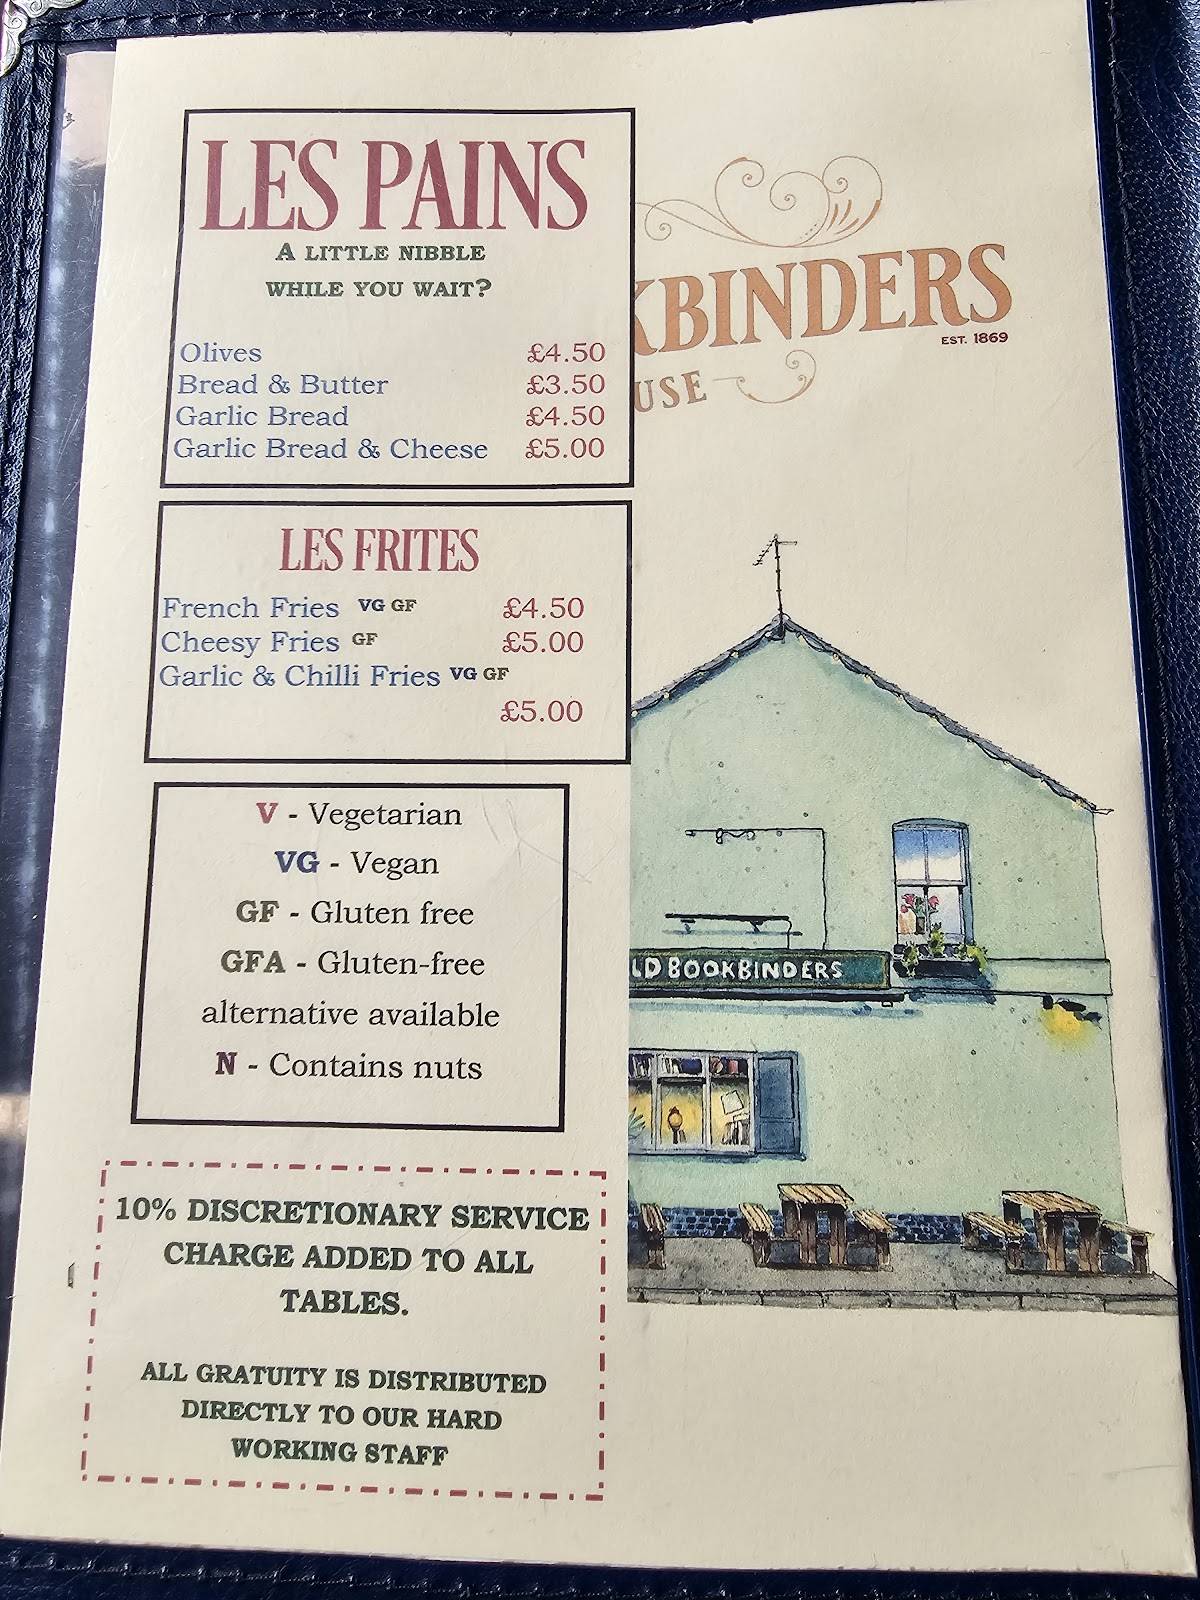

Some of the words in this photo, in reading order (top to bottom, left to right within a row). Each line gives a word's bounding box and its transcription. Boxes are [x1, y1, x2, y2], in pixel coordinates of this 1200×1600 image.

[199, 139, 338, 231] LES
[359, 139, 587, 230] PAINS
[275, 243, 296, 261] A
[305, 245, 389, 261] LITTLE
[399, 246, 486, 261] NIBBLE
[265, 282, 344, 298] WHILE
[353, 282, 404, 297] YOU
[413, 278, 492, 297] WAIT?
[942, 336, 967, 345] EST.
[974, 332, 1008, 343] 1869
[180, 342, 262, 362] Olives
[527, 343, 605, 363] £4.50
[177, 374, 258, 394] Bread
[268, 374, 290, 394] &
[300, 375, 389, 394] Butter
[527, 374, 605, 395] £3.50
[176, 405, 257, 425] Garlic
[268, 405, 348, 426] Bread
[526, 406, 604, 426] £4.50
[174, 437, 256, 458] Garlic
[265, 438, 347, 458] Bread
[358, 439, 380, 458] &
[390, 438, 487, 459] Cheese
[525, 438, 604, 458] £5.00
[278, 528, 343, 571] LES
[352, 528, 479, 572] FRITES
[162, 596, 259, 618] French
[270, 597, 340, 618] Fries
[358, 599, 386, 611] VG
[390, 599, 417, 612] GF
[503, 597, 584, 619] £4.50
[162, 631, 261, 658] Cheesy
[271, 630, 339, 652] Fries
[352, 633, 378, 645] GF
[502, 631, 583, 653] £5.00
[160, 664, 243, 686] Garlic
[253, 665, 275, 686] &
[285, 664, 360, 686] Chilli
[370, 665, 440, 686] Fries
[449, 667, 477, 680] VG
[483, 667, 509, 680] GF
[500, 700, 583, 722] £5.00
[256, 802, 278, 824] V
[308, 802, 462, 831] Vegetarian
[274, 851, 320, 873] VG
[350, 851, 439, 880] Vegan
[236, 900, 279, 922] GF
[311, 900, 410, 924] Gluten
[420, 901, 473, 925] free
[221, 950, 286, 973] GFA
[318, 950, 485, 976] Gluten-free
[668, 956, 843, 979] BOOKBINDERS
[202, 999, 358, 1025] alternative
[369, 1001, 500, 1027] available
[215, 1052, 238, 1075] N
[270, 1053, 403, 1078] Contains
[413, 1057, 482, 1080] nuts
[116, 1197, 176, 1221] 10%
[187, 1199, 442, 1227] DISCRETIONARY
[451, 1205, 590, 1231] SERVICE
[164, 1242, 295, 1268] CHARGE
[302, 1245, 412, 1271] ADDED
[422, 1248, 465, 1272] TO
[474, 1249, 534, 1274] ALL
[280, 1289, 408, 1316] TABLES.
[140, 1362, 188, 1383] ALL
[196, 1363, 327, 1387] GRATUITY
[335, 1368, 360, 1389] IS
[368, 1369, 546, 1394] DISTRIBUTED
[181, 1400, 311, 1423] DIRECTLY
[318, 1405, 354, 1425] TO
[363, 1407, 419, 1427] OUR
[426, 1409, 502, 1430] HARD
[231, 1438, 358, 1462] WORKING
[365, 1443, 448, 1466] STAFF
